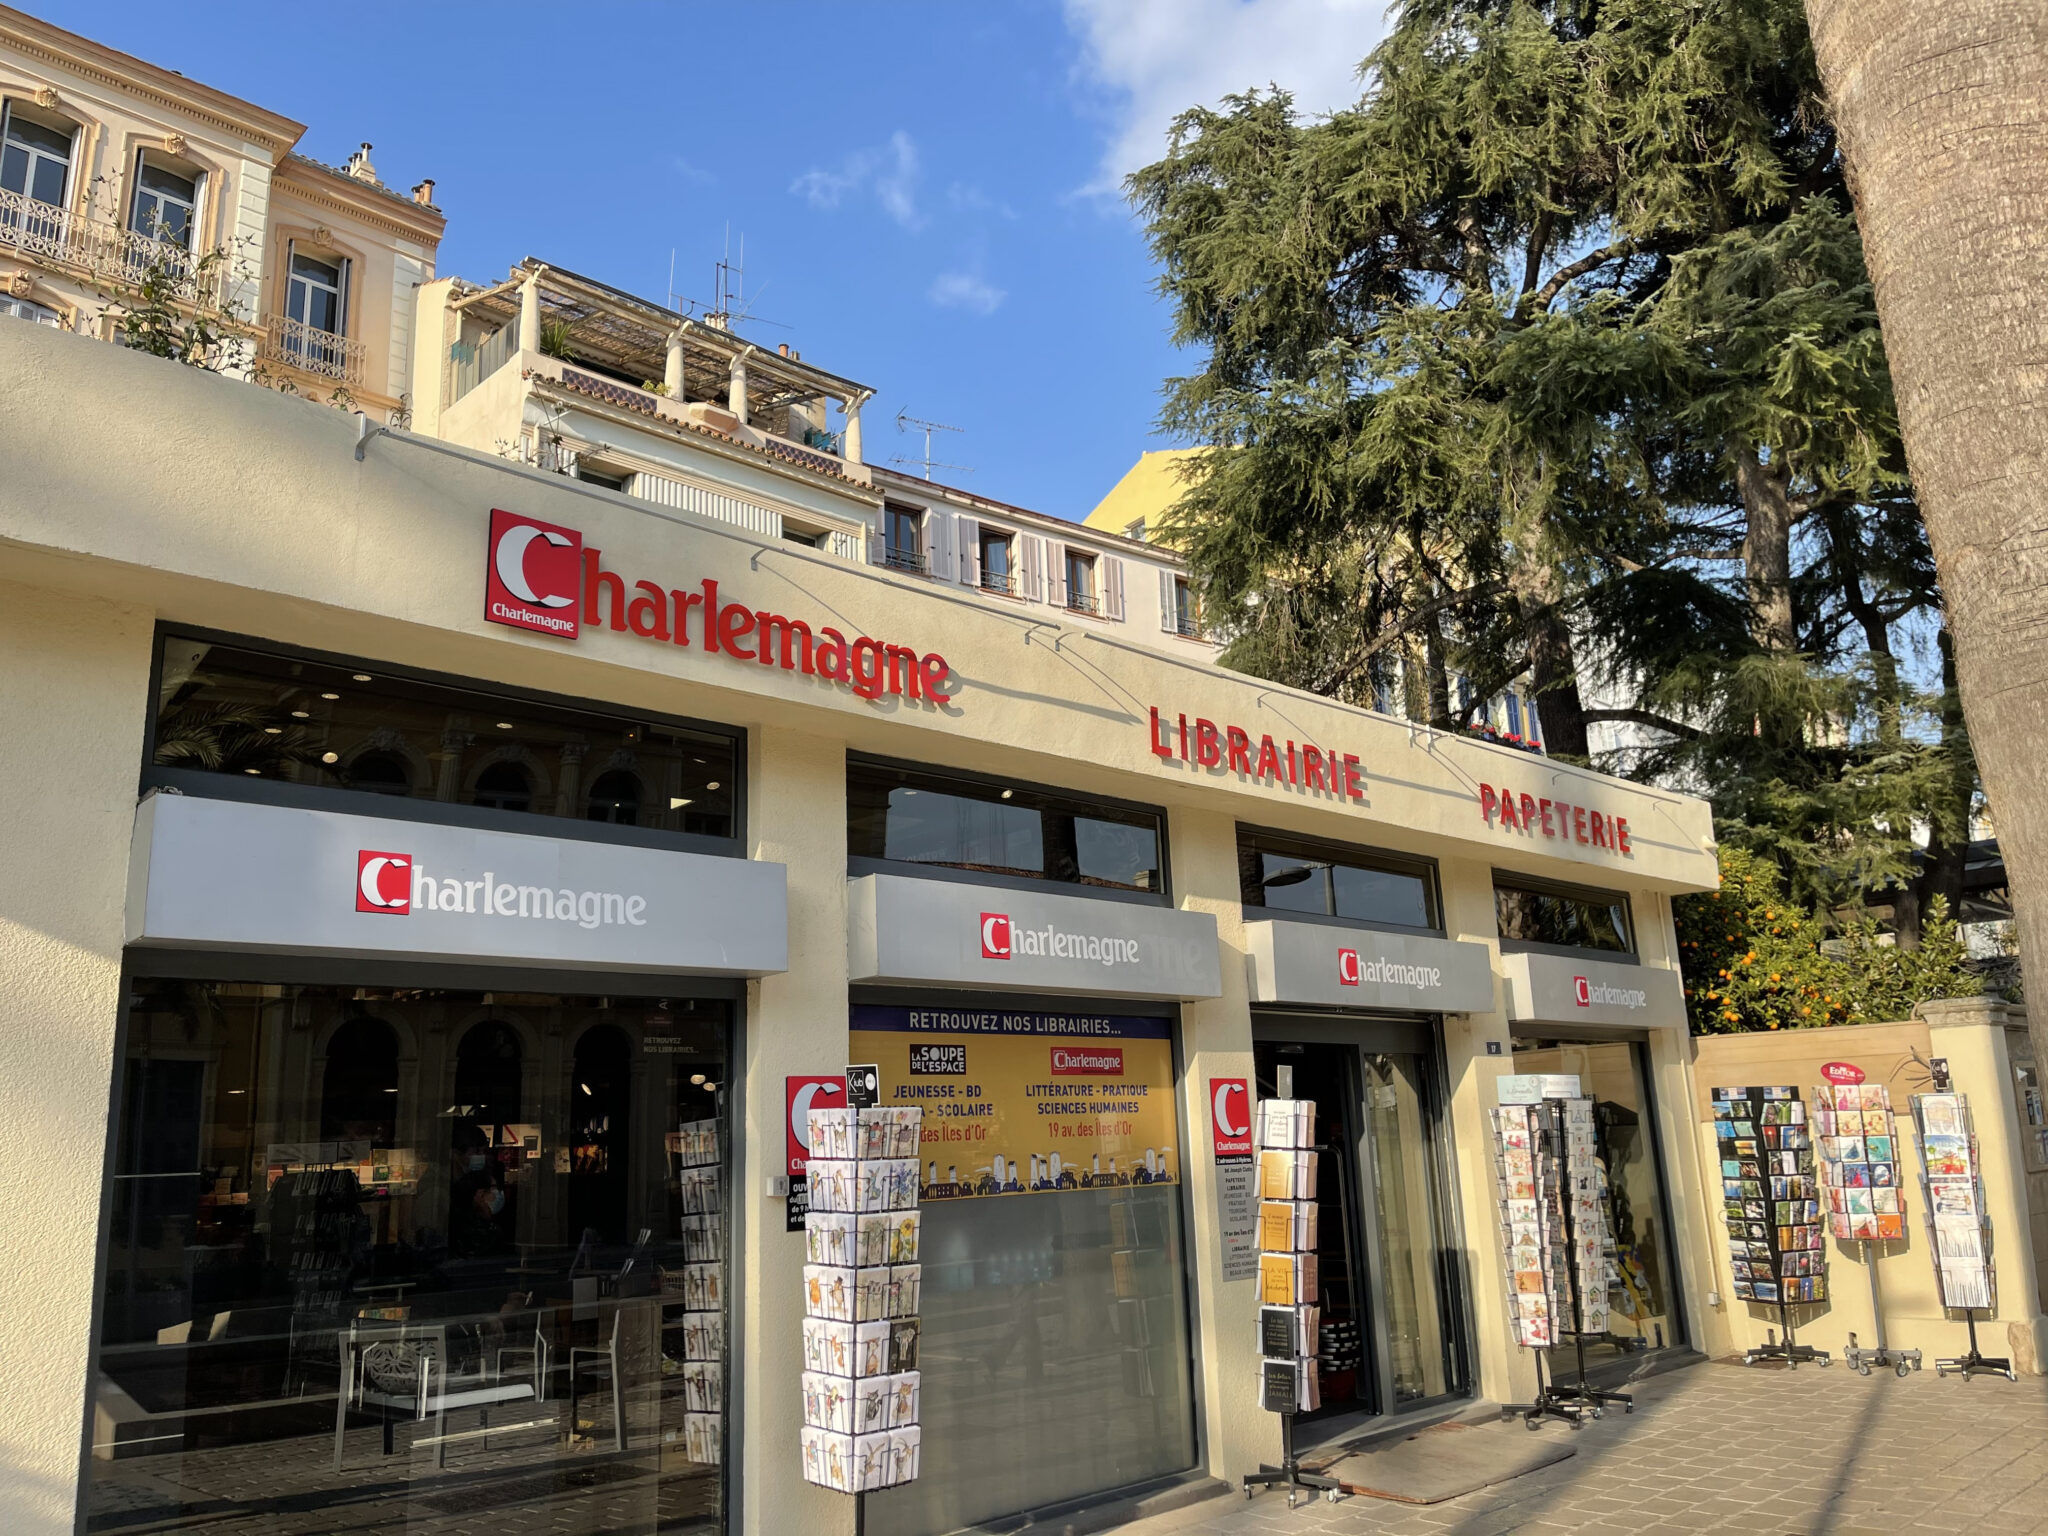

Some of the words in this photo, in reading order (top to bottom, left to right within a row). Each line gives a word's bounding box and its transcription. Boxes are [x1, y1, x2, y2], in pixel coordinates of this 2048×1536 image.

[492, 602, 574, 632] Charlemagne
[496, 525, 950, 704] Charlemagne
[1150, 705, 1364, 799] LIBRAIRIE
[1480, 783, 1631, 853] PAPETERIE
[360, 857, 647, 929] Charlemagne
[983, 918, 1140, 966] Charlemagne
[1340, 952, 1441, 989] Charlemagne
[1576, 979, 1646, 1009] Charlemagne
[909, 1012, 998, 1031] RETROUVEZ
[1003, 1016, 1031, 1032] NOS
[1036, 1017, 1121, 1035] LIBRAIRIES...
[911, 1053, 921, 1061] LA
[921, 1047, 965, 1061] SOUPE
[1054, 1052, 1121, 1070] Charlemagne
[921, 1061, 965, 1072] L'ESPACE
[893, 1085, 955, 1098] JEUNESSE
[966, 1085, 982, 1098] BD
[1026, 1081, 1093, 1097] LITTÉRATURE
[1103, 1085, 1148, 1096] PRATIQUE
[937, 1103, 993, 1117] SCOLAIRE
[1038, 1102, 1087, 1115] SCIENCES
[1089, 1101, 1139, 1114] HUMAINES
[920, 1125, 939, 1142] des
[942, 1121, 964, 1142] Îles
[965, 1124, 986, 1141] d'Or
[1048, 1122, 1059, 1137] 19
[1062, 1126, 1075, 1137] av.
[1078, 1122, 1093, 1137] des
[1095, 1118, 1112, 1136] Îles
[1114, 1121, 1132, 1136] d'Or
